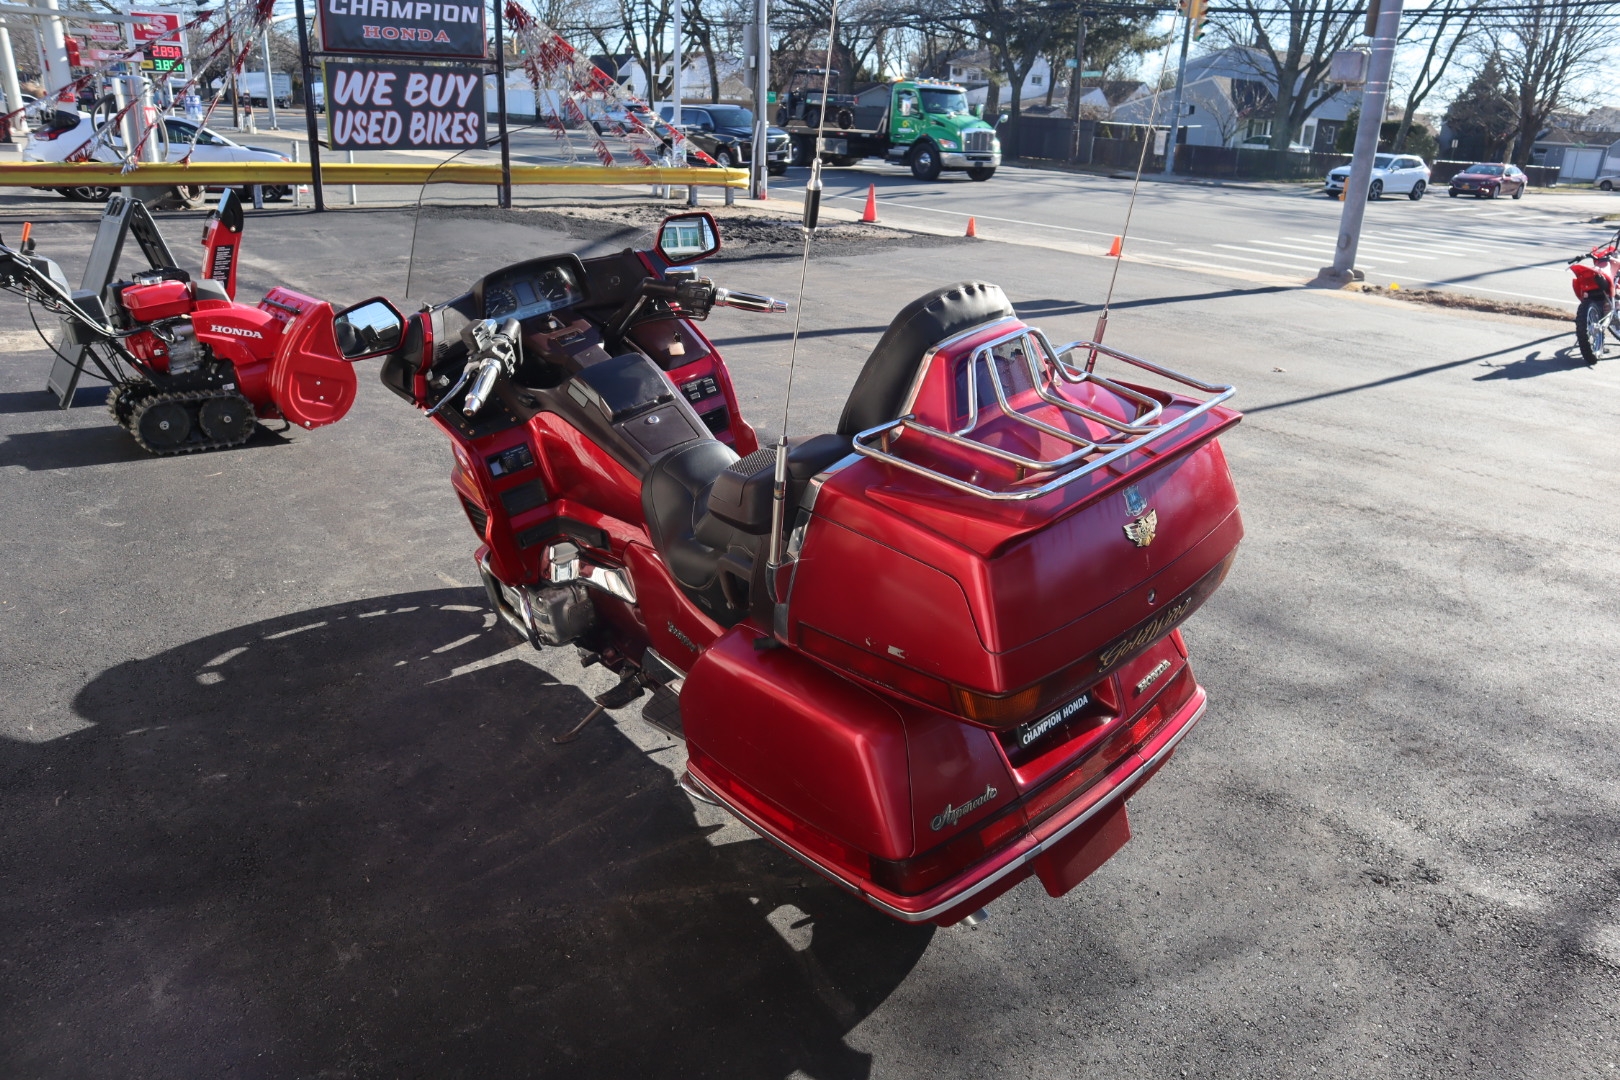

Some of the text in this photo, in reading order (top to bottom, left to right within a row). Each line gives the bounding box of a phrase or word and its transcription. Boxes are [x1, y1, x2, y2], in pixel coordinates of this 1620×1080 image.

[329, 0, 478, 23] CHAMPION
[363, 25, 450, 42] HONDA
[333, 70, 478, 108] WE BUY
[333, 110, 479, 145] USED BIKES
[210, 324, 263, 339] HONDA
[1022, 694, 1089, 744] CHAMPION HONDA
